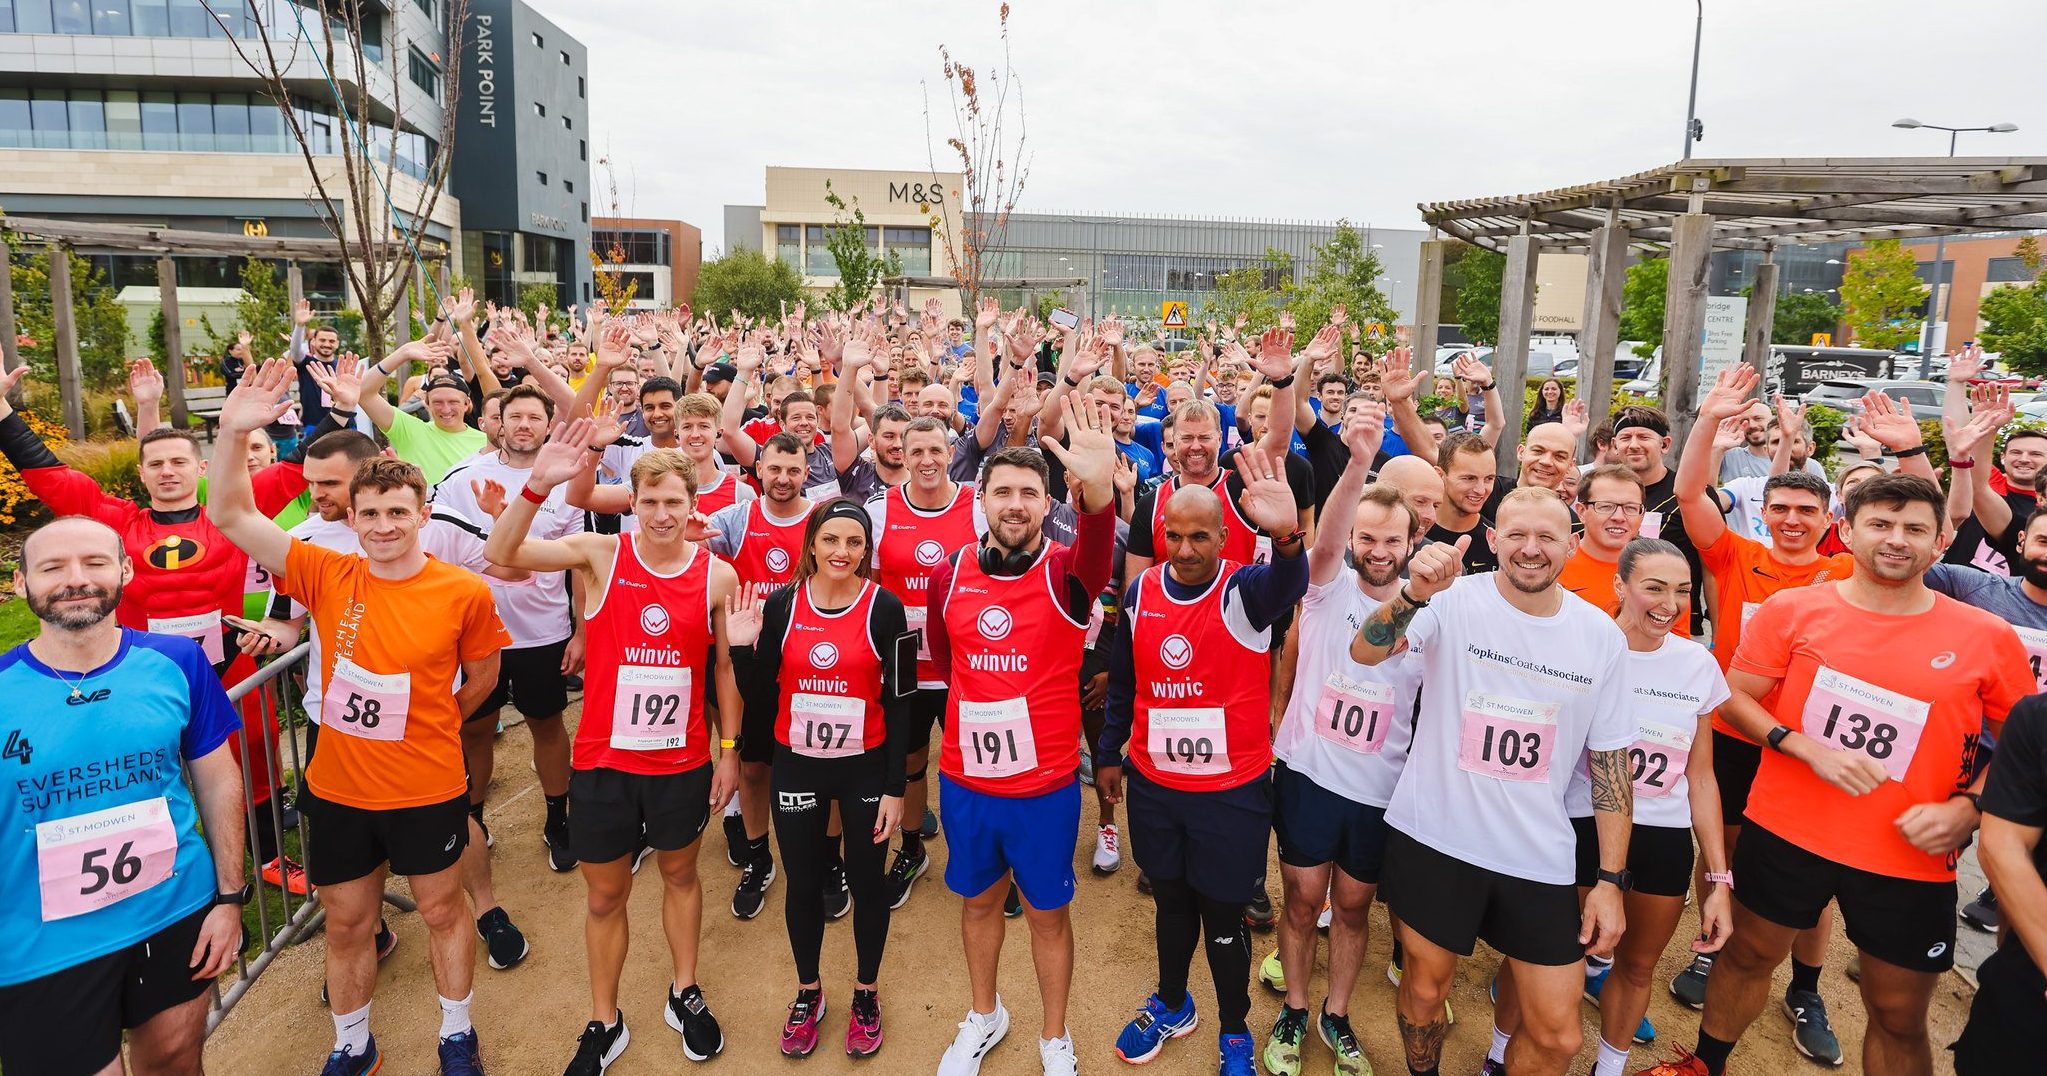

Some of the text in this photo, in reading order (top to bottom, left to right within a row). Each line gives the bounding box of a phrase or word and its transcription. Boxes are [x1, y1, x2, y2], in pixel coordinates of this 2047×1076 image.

[476, 15, 496, 128] PARK POINT
[889, 181, 944, 204] M&S
[1539, 315, 1576, 324] FOODHALL
[624, 642, 681, 666] winvic
[966, 648, 1028, 672] winvic
[798, 675, 849, 693] winvic
[342, 691, 382, 729] 58
[630, 693, 681, 726] 192
[1331, 699, 1379, 742] 101
[2, 729, 34, 766] 4
[666, 737, 680, 747] 192
[805, 720, 852, 750] 197
[972, 729, 1018, 765] 191
[1482, 725, 1541, 769] 103
[1822, 703, 1898, 760] 138
[1165, 737, 1214, 764] 199
[16, 748, 166, 796] EVERSHEDS
[21, 765, 163, 814] SUTHERLAND
[80, 840, 142, 896] 56
